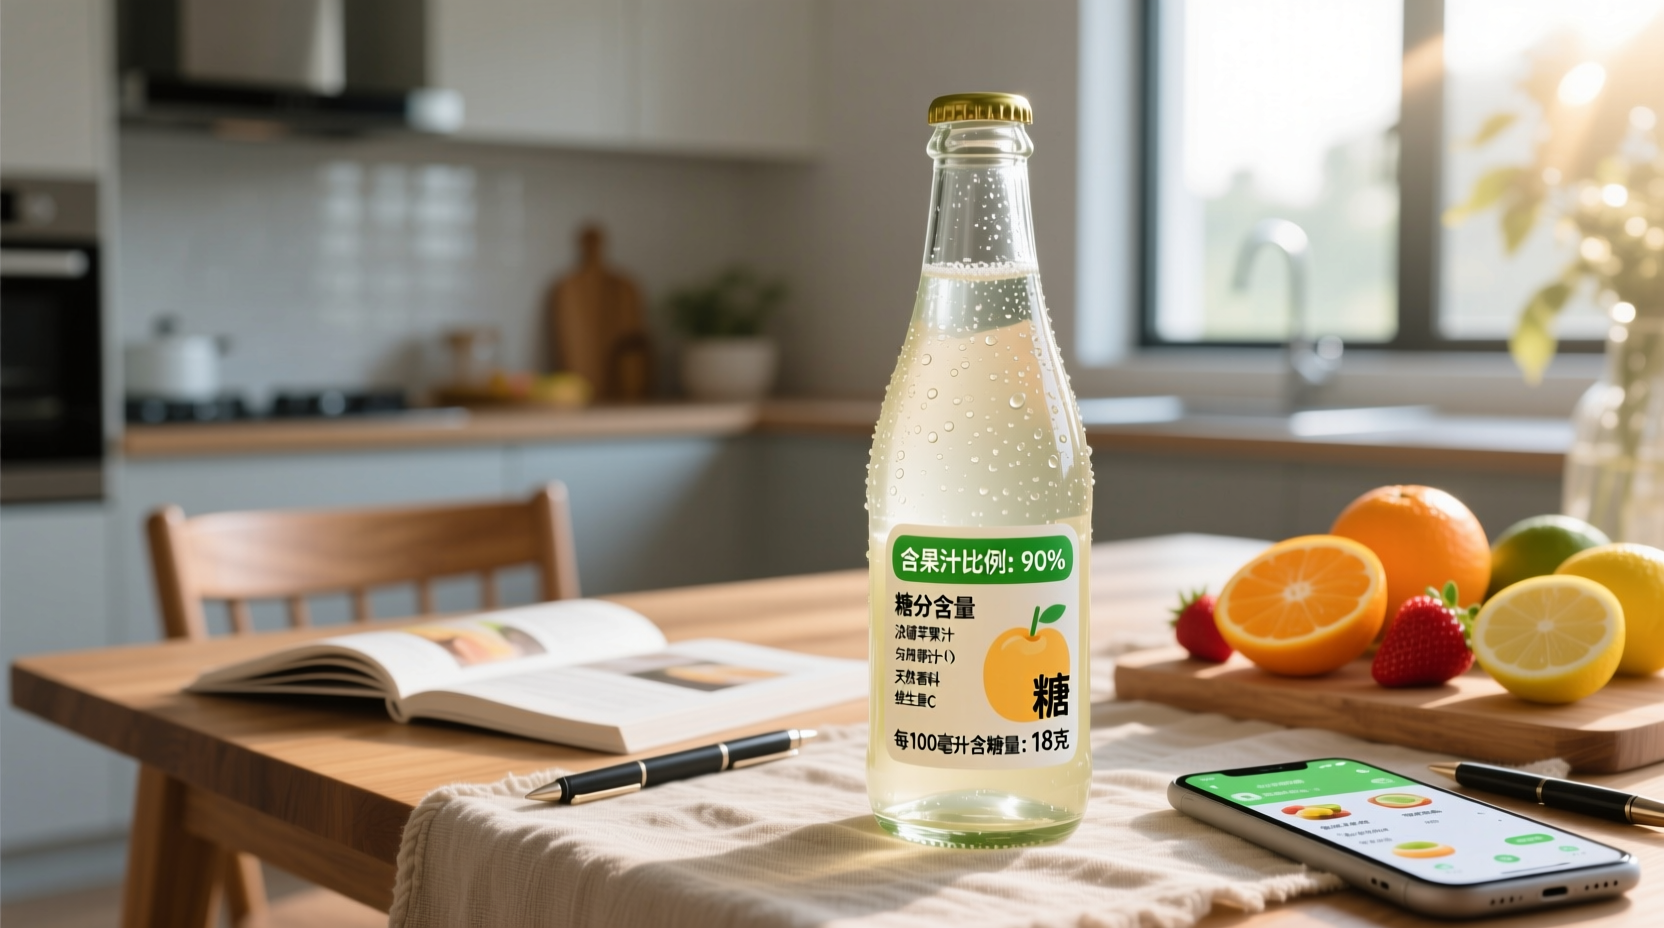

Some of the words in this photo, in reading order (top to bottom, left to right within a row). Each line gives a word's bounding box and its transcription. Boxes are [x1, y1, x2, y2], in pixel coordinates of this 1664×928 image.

[1021, 548, 1066, 572] 90%
[894, 591, 976, 620] 糖分含量
[1032, 672, 1070, 720] 糖
[1031, 727, 1070, 752] 18克
